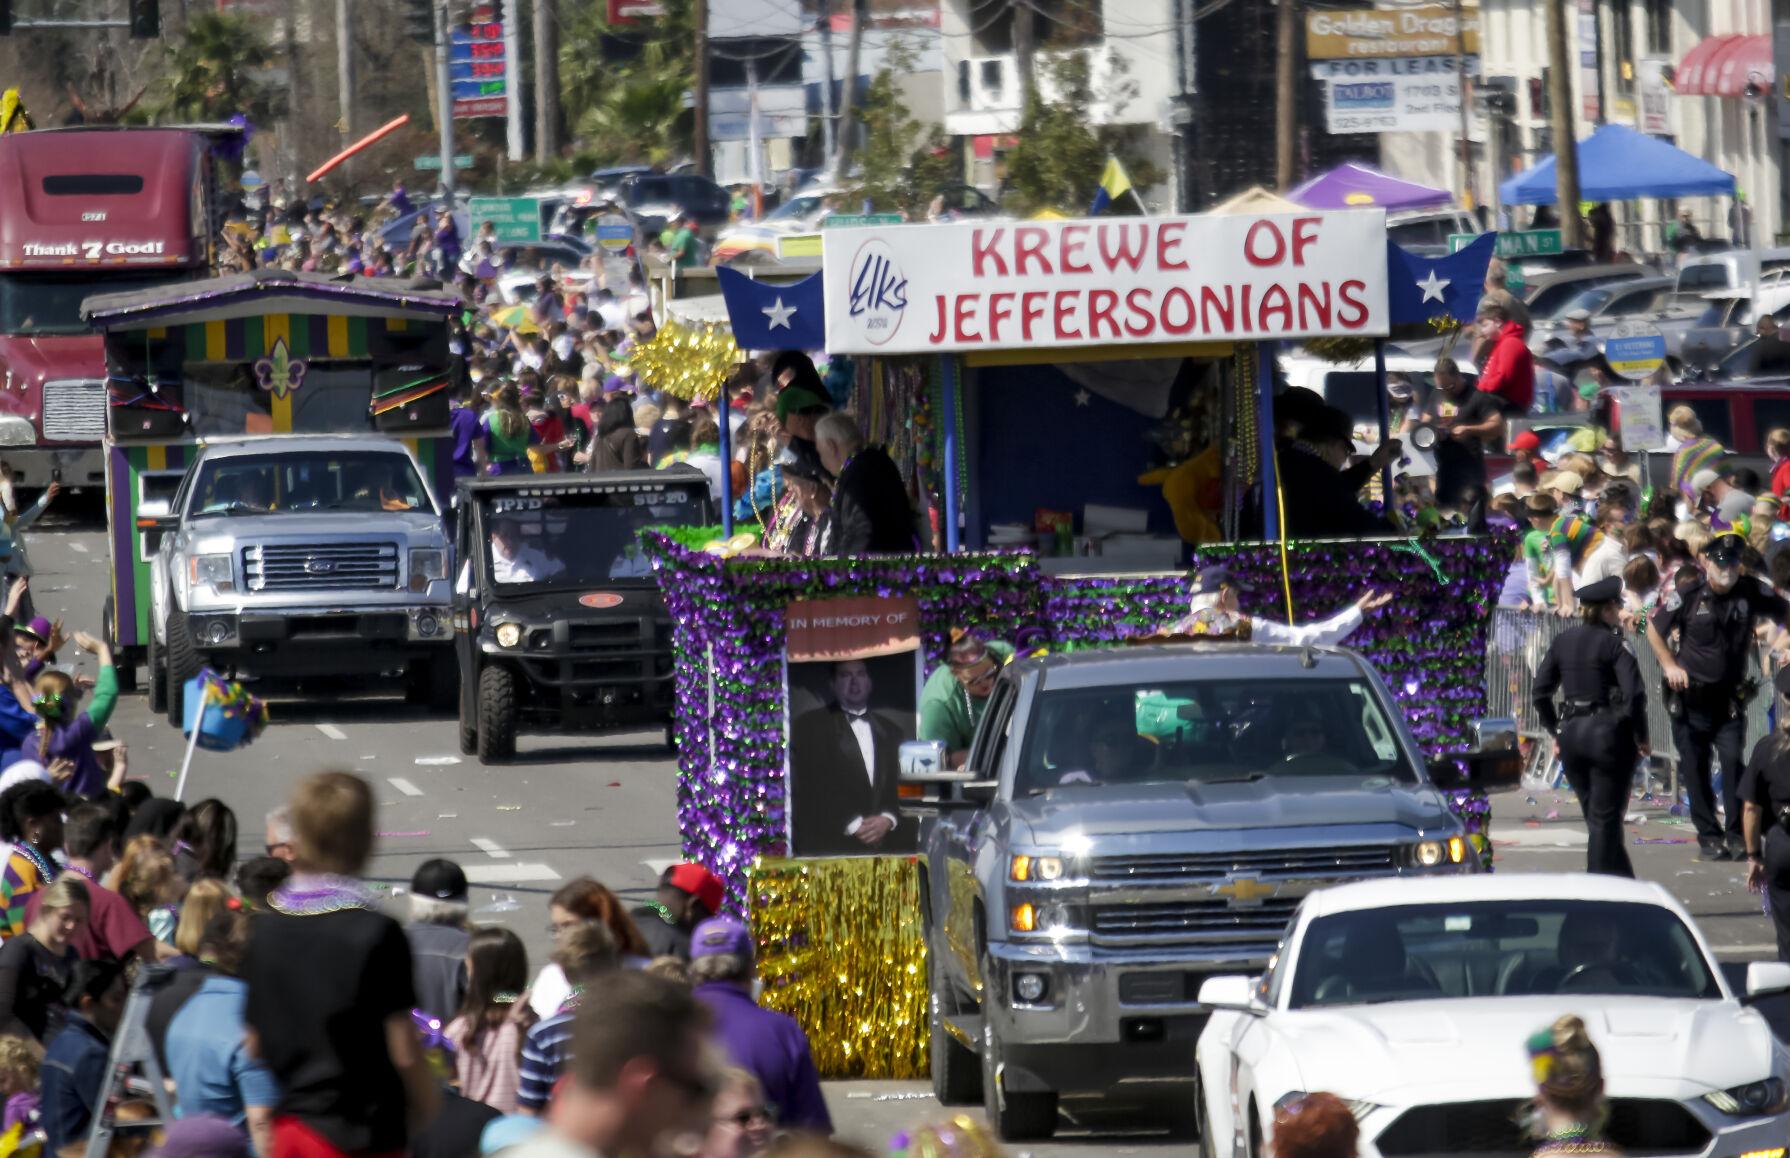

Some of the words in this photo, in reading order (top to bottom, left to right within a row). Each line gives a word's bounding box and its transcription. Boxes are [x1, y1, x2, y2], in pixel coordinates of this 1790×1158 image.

[1310, 12, 1395, 36] Golden
[1347, 38, 1449, 54] restaurant
[1329, 61, 1379, 75] FOR
[1391, 57, 1474, 75] LEASE
[22, 241, 79, 256] Thank
[106, 240, 165, 255] God!
[971, 222, 1191, 278] KREWE
[1243, 216, 1324, 269] OF
[848, 252, 909, 317] Elks
[928, 279, 1370, 346] JEFFERSONIANS
[790, 618, 808, 630] IN
[812, 614, 880, 629] MEMORY
[886, 611, 907, 625] OF
